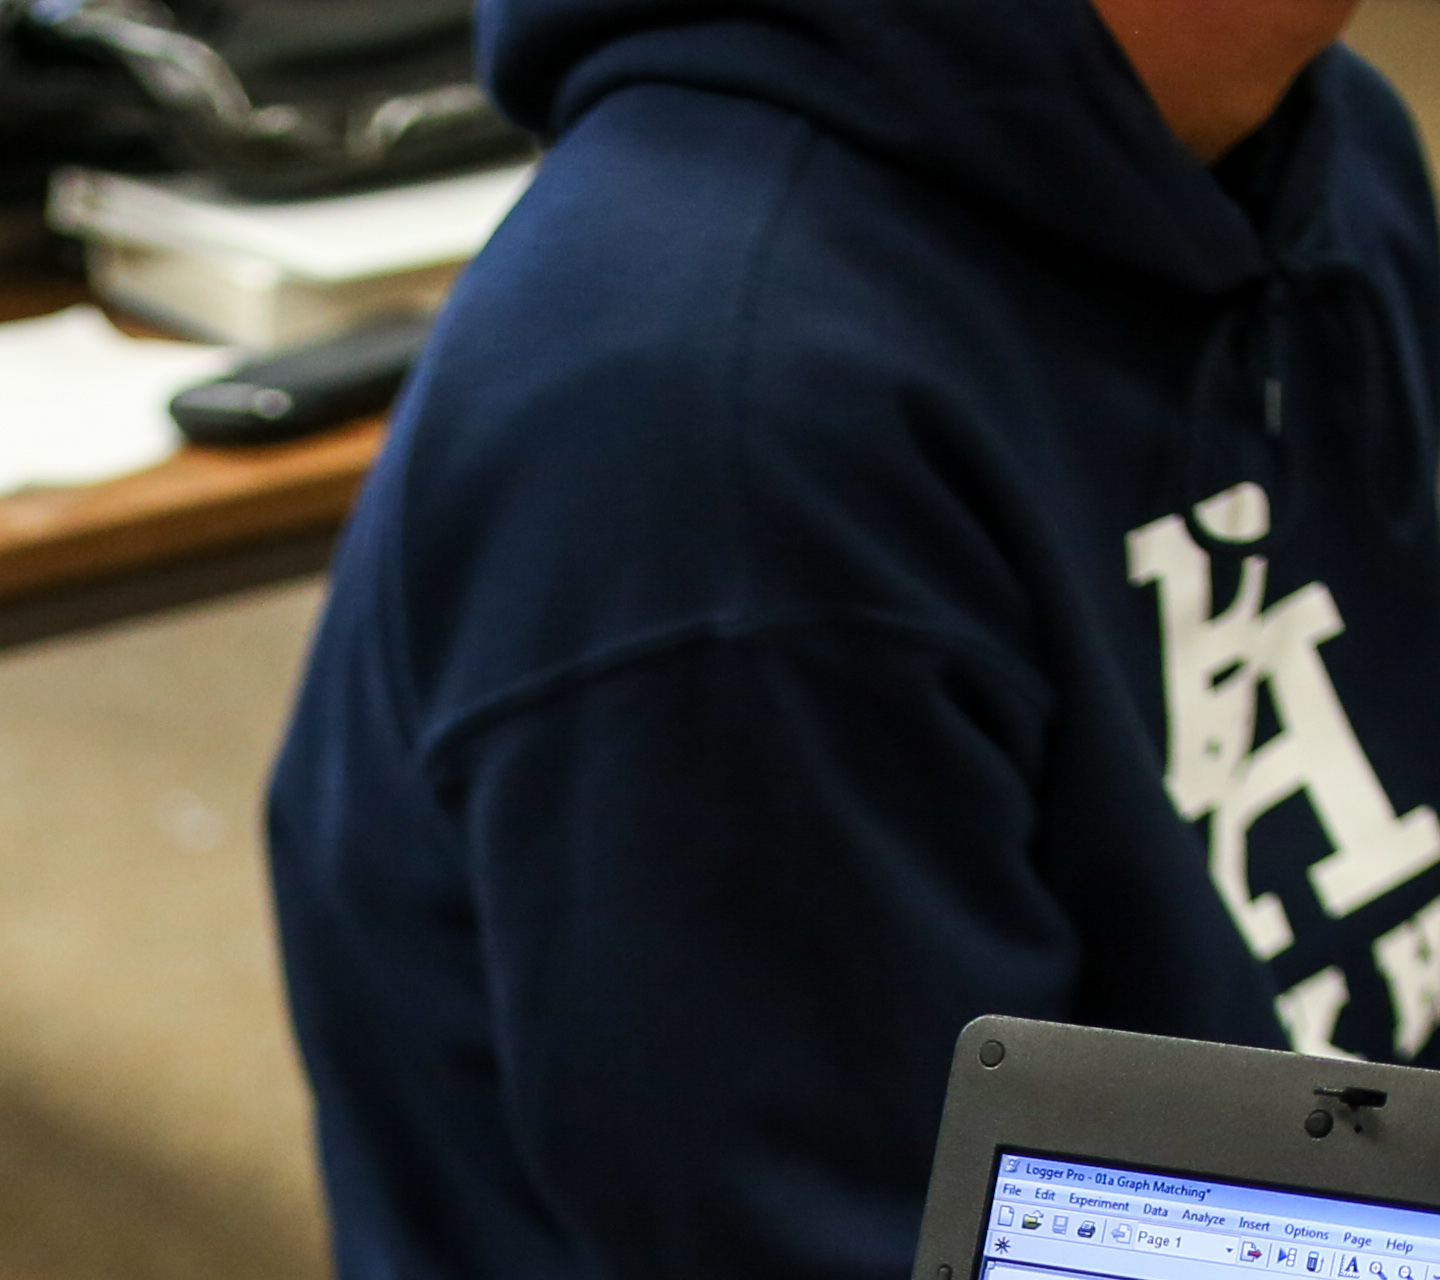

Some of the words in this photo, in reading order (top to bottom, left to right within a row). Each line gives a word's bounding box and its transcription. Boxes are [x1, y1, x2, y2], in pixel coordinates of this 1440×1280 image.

[1026, 1163, 1063, 1180] Logger
[1066, 1169, 1084, 1182] Pro
[1094, 1173, 1114, 1186] 01a
[1117, 1177, 1150, 1195] Graph
[1003, 1184, 1022, 1197] File
[1035, 1188, 1056, 1201] Edit
[1070, 1193, 1130, 1212] Experiment
[1143, 1203, 1168, 1217] Data
[1182, 1209, 1226, 1227] Analyze
[1239, 1218, 1270, 1232] Insert
[1285, 1224, 1329, 1241] Options
[1344, 1232, 1372, 1247] Page
[1386, 1238, 1414, 1255] Help
[1137, 1231, 1170, 1248] Page
[1175, 1237, 1182, 1248] 1
